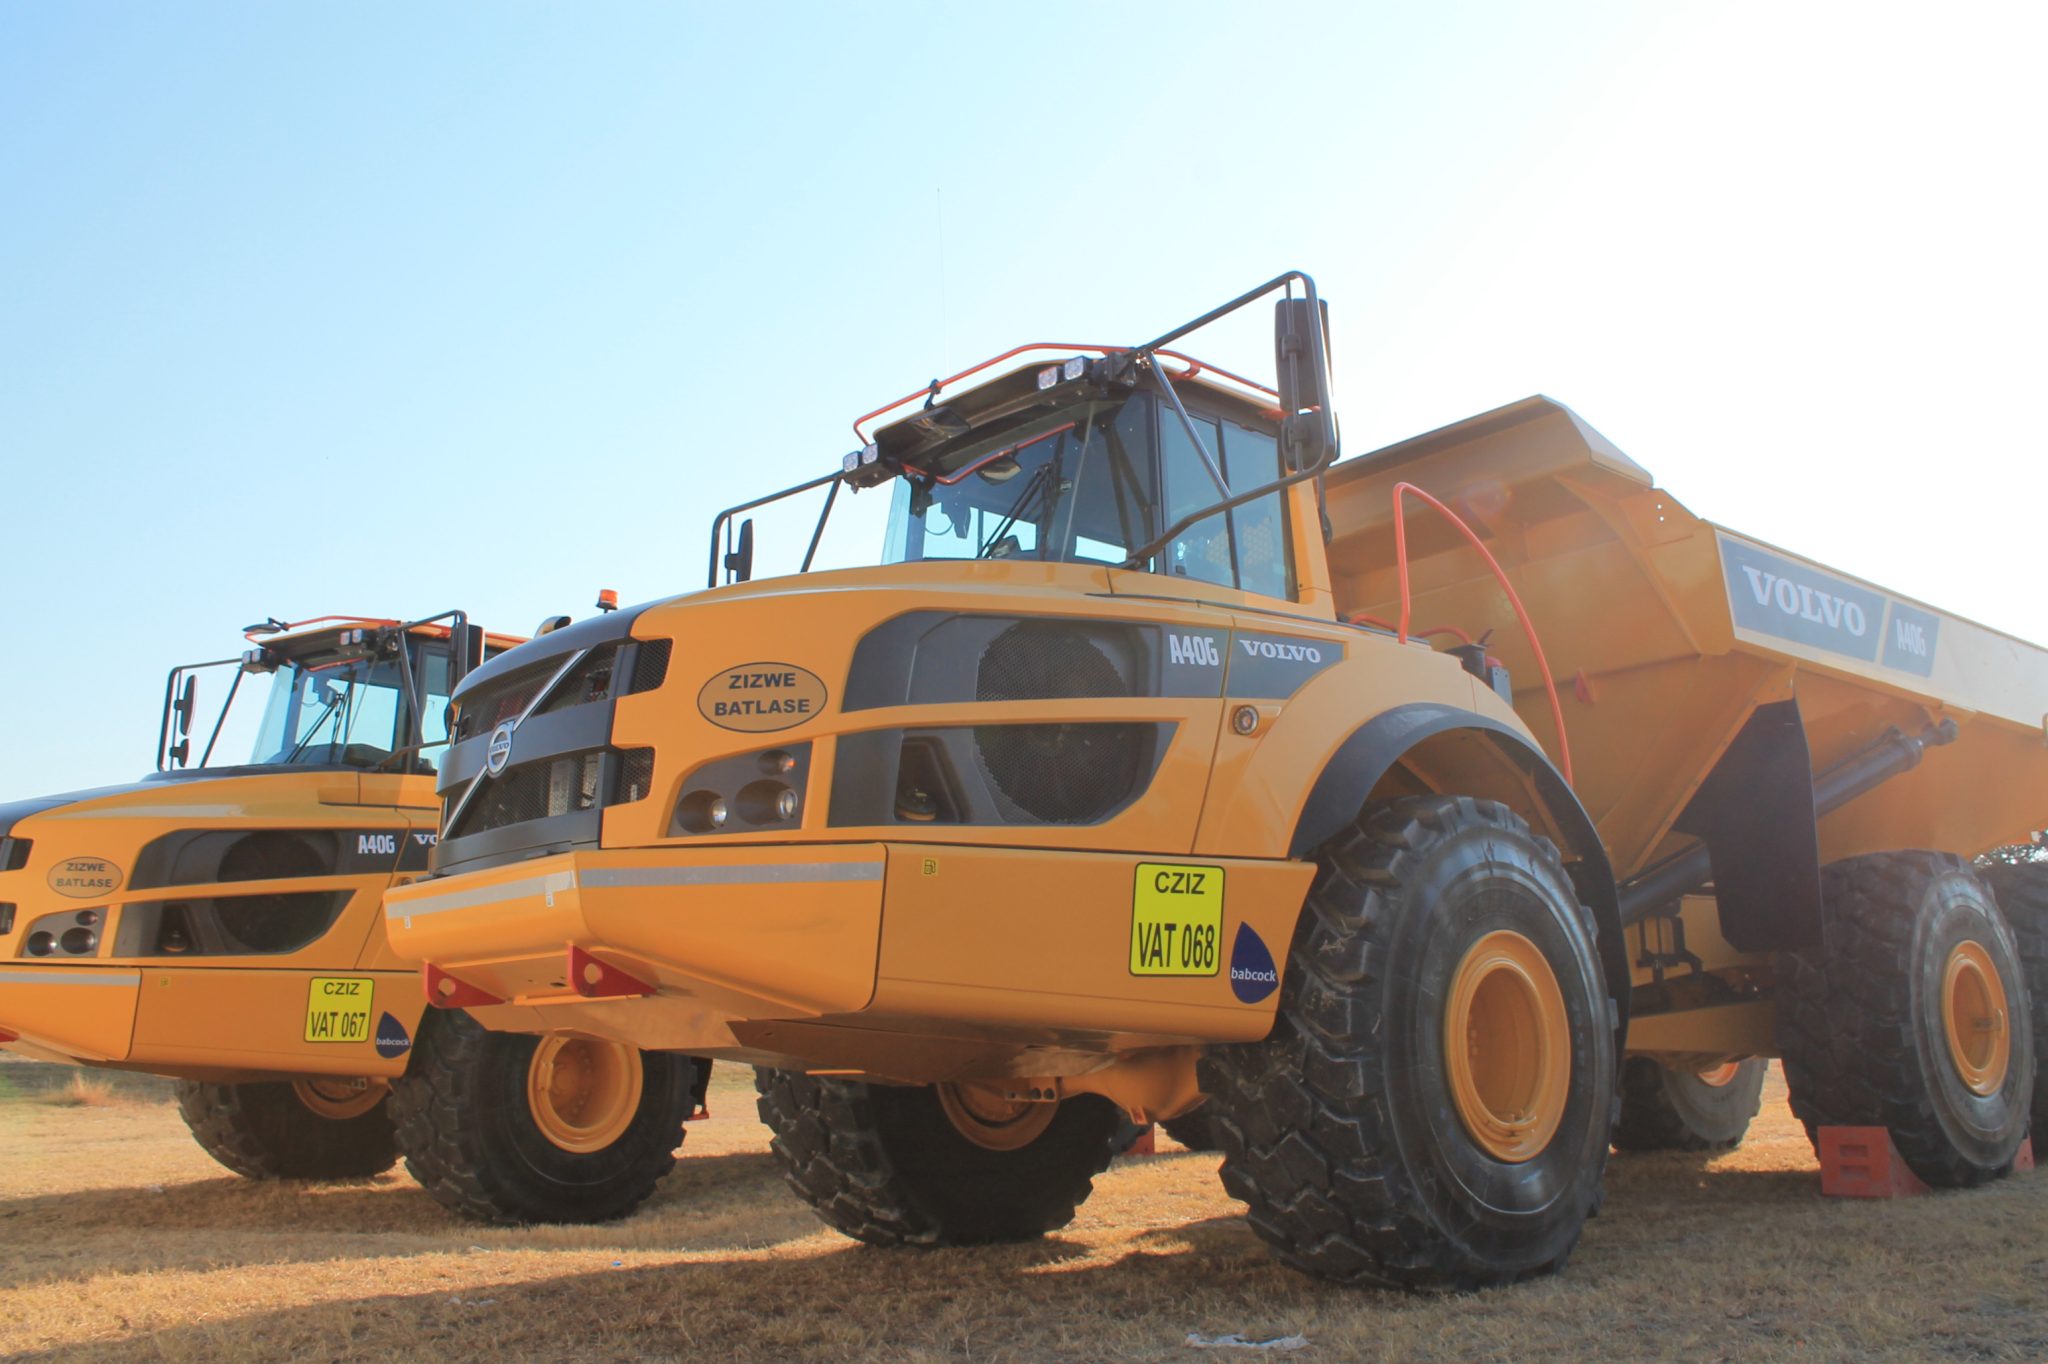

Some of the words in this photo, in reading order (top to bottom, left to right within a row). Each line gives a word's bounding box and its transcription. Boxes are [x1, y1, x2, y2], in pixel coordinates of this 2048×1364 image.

[1742, 564, 1866, 637] VOLVO
[1169, 634, 1219, 666] A40G
[1240, 639, 1321, 663] VOLVO
[729, 672, 796, 690] ZIZWE
[714, 698, 810, 716] BATLASE
[357, 834, 396, 855] A40G
[65, 862, 106, 872] ZIZWE
[56, 878, 113, 888] BATLASE
[1155, 871, 1205, 895] CZIZ
[1138, 922, 1177, 968] VAT
[1181, 923, 1215, 969] 068
[1231, 967, 1276, 982] babcock
[323, 982, 361, 996] CZIZ
[311, 1011, 339, 1038] VAT
[341, 1011, 367, 1038] 067
[375, 1037, 410, 1046] babcock
